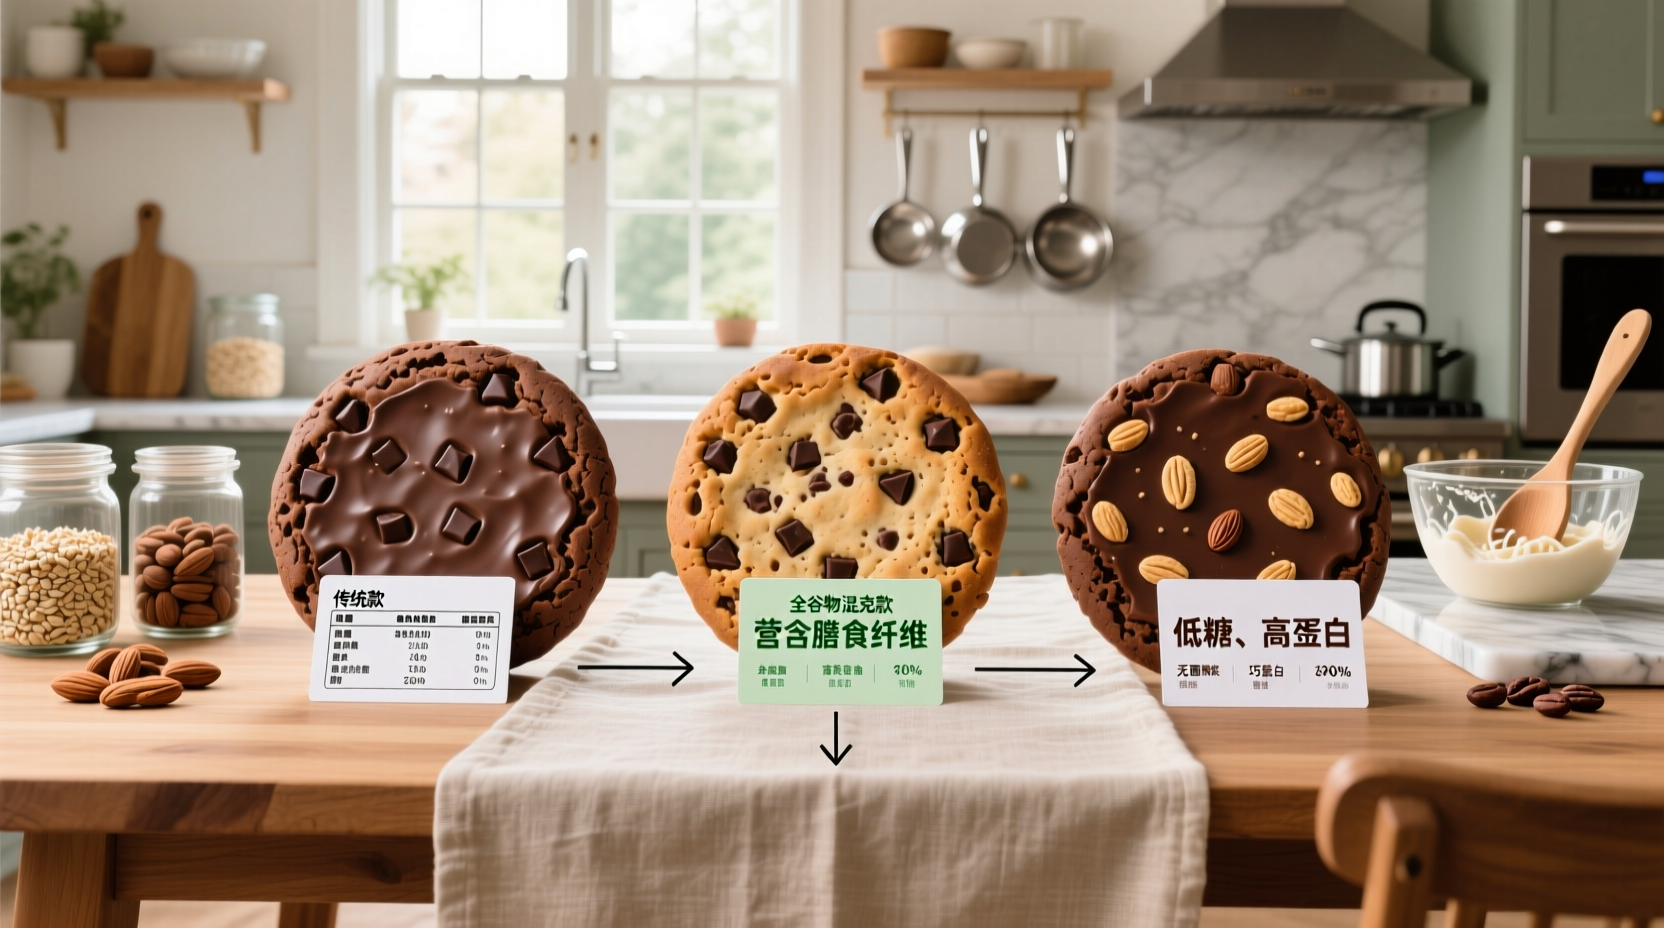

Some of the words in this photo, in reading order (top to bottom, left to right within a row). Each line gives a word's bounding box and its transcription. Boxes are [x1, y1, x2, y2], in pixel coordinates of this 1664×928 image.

[333, 589, 385, 608] 传统款
[754, 617, 928, 650] 营含膳食纤维
[1173, 616, 1350, 649] 低糖、高蛋白
